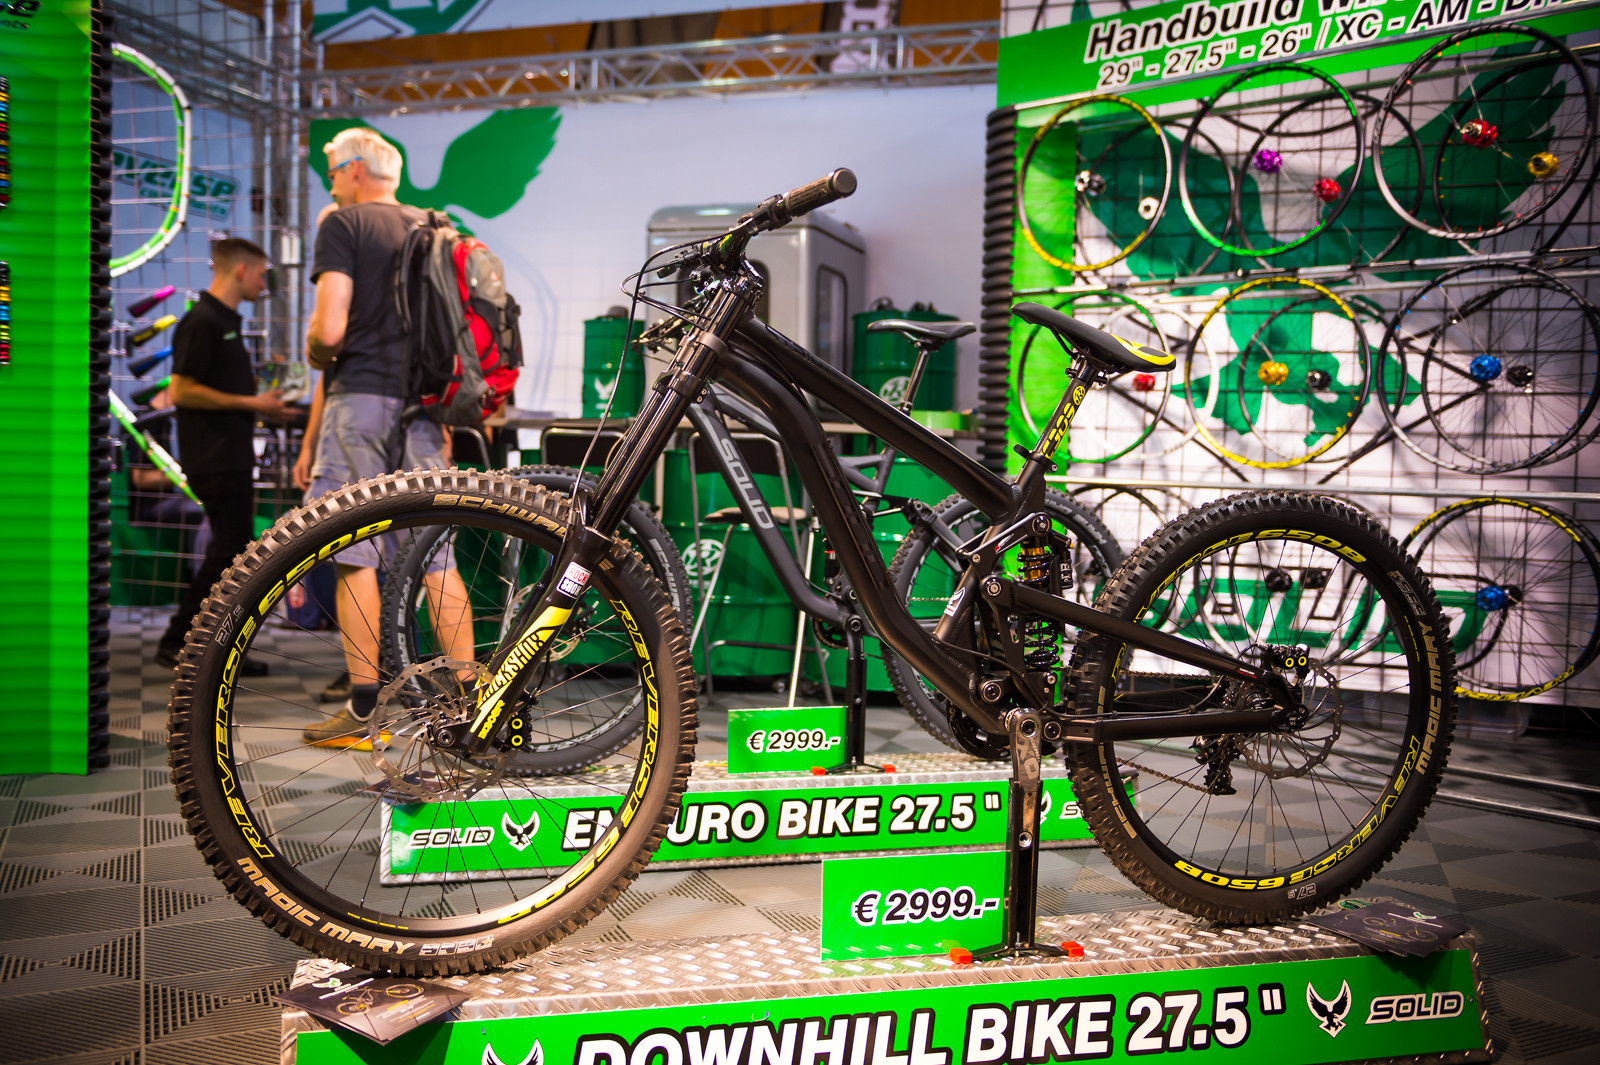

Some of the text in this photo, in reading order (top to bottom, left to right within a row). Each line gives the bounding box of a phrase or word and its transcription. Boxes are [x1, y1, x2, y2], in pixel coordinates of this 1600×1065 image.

[1084, 0, 1303, 62] Handbuild
[1163, 38, 1236, 78] 27.5"
[1259, 23, 1311, 60] 26"
[1329, 9, 1383, 48] XC
[1407, 0, 1472, 33] AM
[720, 438, 774, 529] SOLID
[258, 519, 393, 616] 650B
[1255, 529, 1367, 563] 650B
[215, 605, 245, 646] 27.5
[610, 599, 660, 828] REVERSE
[1415, 621, 1442, 775] MAGIC MARY
[216, 615, 274, 859] REVERSE
[748, 729, 840, 752] € 2999.-
[408, 827, 494, 849] SOLID
[561, 801, 768, 851] EURO
[777, 794, 880, 840] BIKE
[889, 793, 975, 832] 27.5
[1174, 735, 1421, 890] REVERSE 650B
[237, 856, 320, 927] MAGIC
[319, 921, 415, 954] MARY
[853, 887, 998, 926] € 2999.-
[967, 994, 1114, 1062] BIKE
[1126, 987, 1251, 1054] 27.5
[1365, 991, 1465, 1025] SOLID
